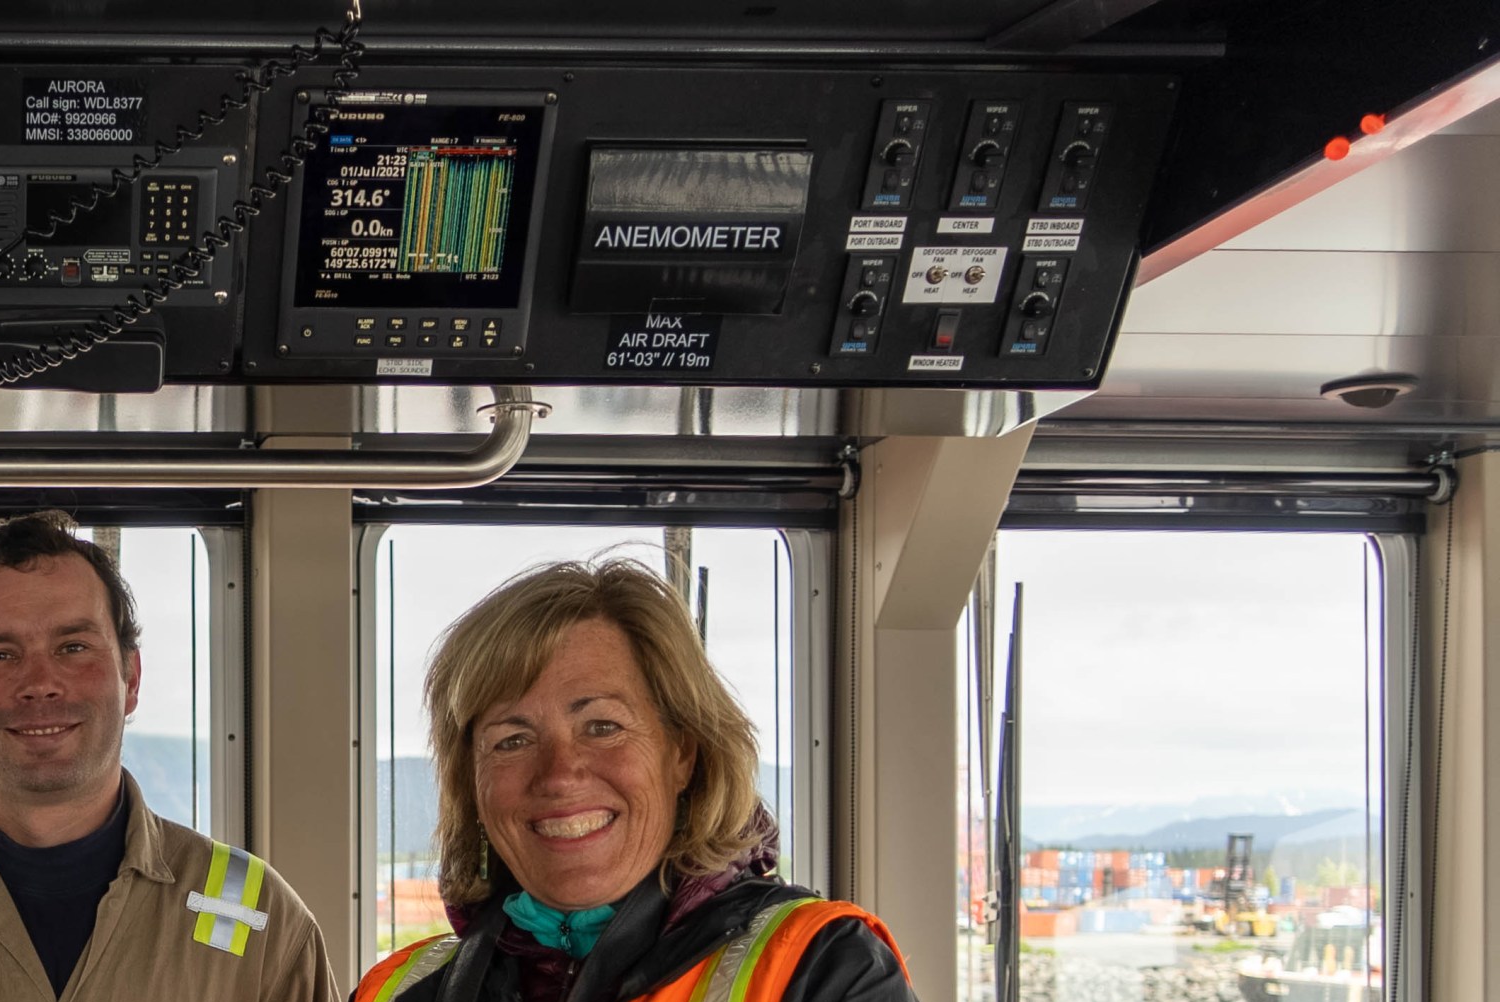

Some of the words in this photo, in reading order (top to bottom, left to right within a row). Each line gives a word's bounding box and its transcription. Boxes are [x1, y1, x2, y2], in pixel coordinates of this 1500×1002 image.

[47, 80, 106, 93] AURORA
[25, 96, 50, 109] Call
[52, 97, 81, 112] sign:
[83, 96, 144, 110] WDL8377
[896, 104, 918, 113] WIPER
[986, 105, 1008, 114] WIPER
[1077, 107, 1100, 115] WIPER
[25, 112, 62, 125] IMO#:
[64, 112, 118, 126] 9920966
[25, 128, 63, 141] MMSI:
[66, 128, 134, 142] 338066000
[376, 154, 407, 166] 21:23
[340, 166, 406, 177] 01/Jul/2021
[330, 188, 391, 207] 314.6°
[149, 208, 155, 216] 4
[149, 221, 155, 229] 7
[853, 219, 872, 229] PORT
[873, 219, 903, 229] INBOARD
[952, 221, 980, 230] CENTER
[1030, 222, 1049, 231] STBD
[1050, 222, 1081, 231] INBOARD
[594, 226, 781, 249] ANEMOMETER
[850, 238, 866, 246] PORT
[867, 238, 899, 246] OUTBOARD
[1026, 238, 1043, 247] STBD
[1044, 238, 1076, 248] OUTBOARD
[922, 248, 958, 256] DEFOGGER
[961, 248, 998, 256] DEFOGGER
[862, 259, 884, 267] WIPER
[932, 256, 945, 264] FAN
[971, 256, 984, 264] FAN
[1036, 259, 1057, 267] WIPER
[911, 271, 924, 279] OFF
[950, 271, 963, 279] OFF
[962, 287, 978, 295] HEAT
[645, 314, 683, 329] MAX
[356, 337, 371, 345] FUNC
[618, 333, 648, 348] AIR
[651, 333, 710, 348] DRAFT
[678, 352, 710, 367] 19m
[912, 358, 935, 367] WINDOW
[935, 359, 960, 368] HEATERS
